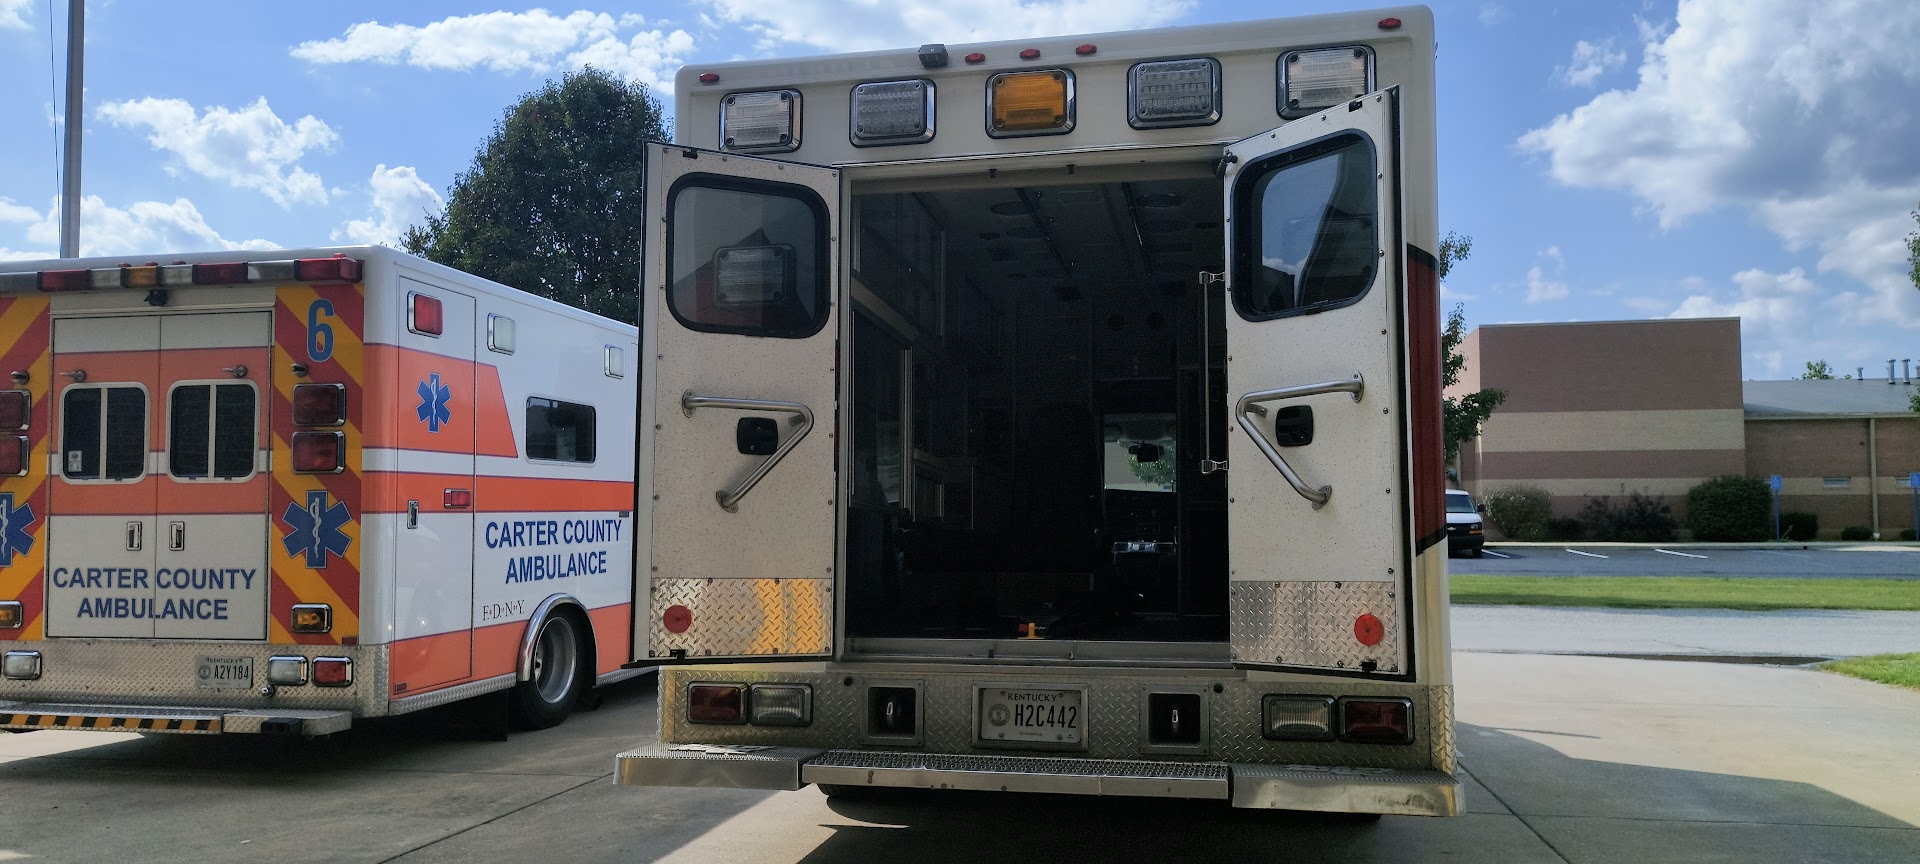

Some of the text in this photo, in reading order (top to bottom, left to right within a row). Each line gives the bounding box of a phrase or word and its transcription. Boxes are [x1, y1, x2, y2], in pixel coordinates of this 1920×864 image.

[307, 298, 334, 363] 6
[485, 519, 622, 549] CARTER COUNTY
[53, 568, 257, 590] CARTER COUNTY
[505, 551, 607, 584] AMBULANCE
[77, 597, 228, 620] AMBULANCE
[213, 665, 249, 680] A2Y184
[1007, 693, 1058, 702] KENTUCKY
[1014, 704, 1077, 728] H2C442
